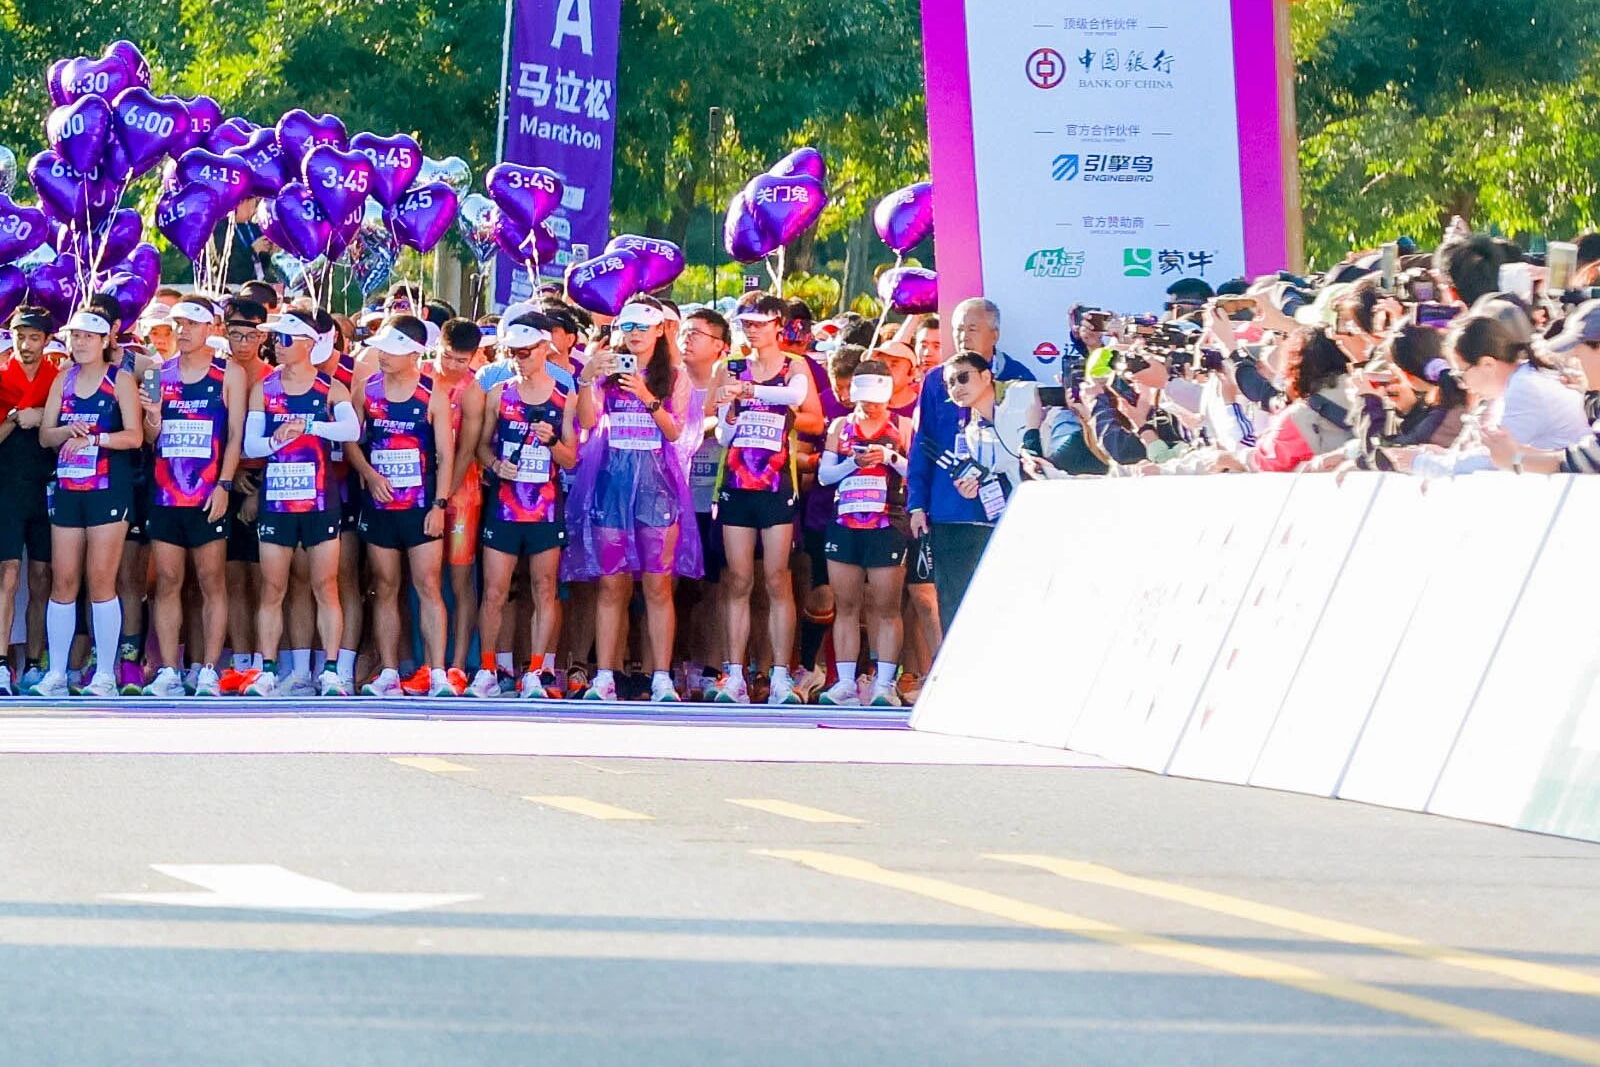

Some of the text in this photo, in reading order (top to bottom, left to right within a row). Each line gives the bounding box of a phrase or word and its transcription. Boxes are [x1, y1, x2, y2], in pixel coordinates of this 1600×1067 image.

[1064, 18, 1138, 30] 顶级合作伙伴
[1078, 48, 1175, 74] 中国银行
[517, 62, 612, 121] 马拉松
[1079, 79, 1174, 89] BANK OF CHINA
[124, 105, 174, 138] 6:00
[1066, 124, 1141, 137] 官方合作伙伴
[364, 147, 412, 169] 3:45
[1084, 154, 1153, 172] 引擎鸟
[200, 165, 240, 185] 4:15
[322, 167, 369, 193] 3:45
[508, 171, 555, 193] 3:45
[1083, 174, 1154, 182] ENGINEBIRD
[756, 185, 809, 204] 关门兔
[158, 202, 186, 228] 4:15
[1082, 216, 1144, 228] 官方赞助商
[625, 238, 675, 261] 关门兔
[1158, 249, 1214, 277] 蒙牛
[169, 434, 205, 445] A3427
[739, 425, 776, 438] A3430
[378, 464, 414, 475] A3423
[271, 476, 309, 488] A3424
